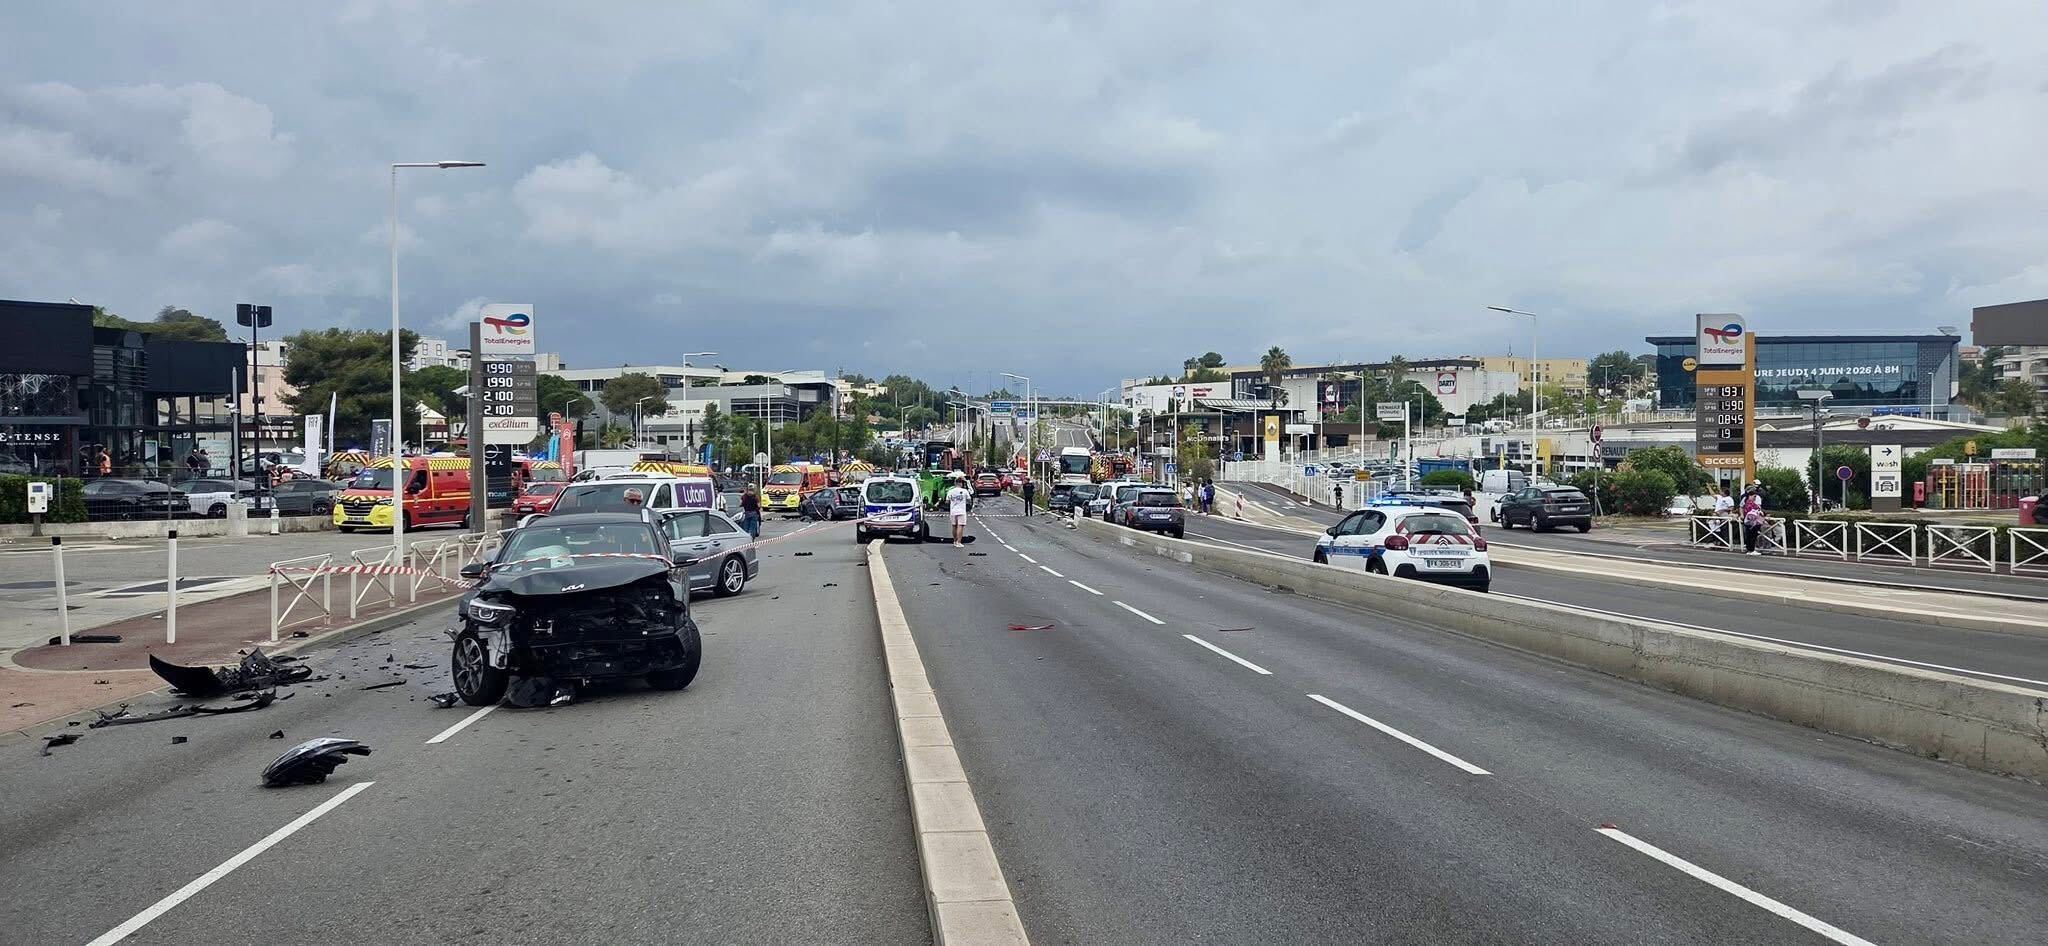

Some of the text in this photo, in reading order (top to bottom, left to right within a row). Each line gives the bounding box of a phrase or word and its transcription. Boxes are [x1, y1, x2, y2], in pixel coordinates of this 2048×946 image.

[484, 337, 531, 346] TotalEnergies
[1703, 347, 1743, 355] TotalEnergies
[1776, 368, 1809, 377] JEUDI
[1811, 368, 1818, 376] 4
[1819, 367, 1844, 375] JUIN
[1846, 366, 1872, 375] 2026
[1874, 365, 1882, 374] À
[1884, 365, 1900, 374] 8H
[488, 418, 529, 429] excellium
[1601, 446, 1627, 456] RENAULT
[1705, 457, 1745, 465] access
[561, 583, 585, 592] KIA
